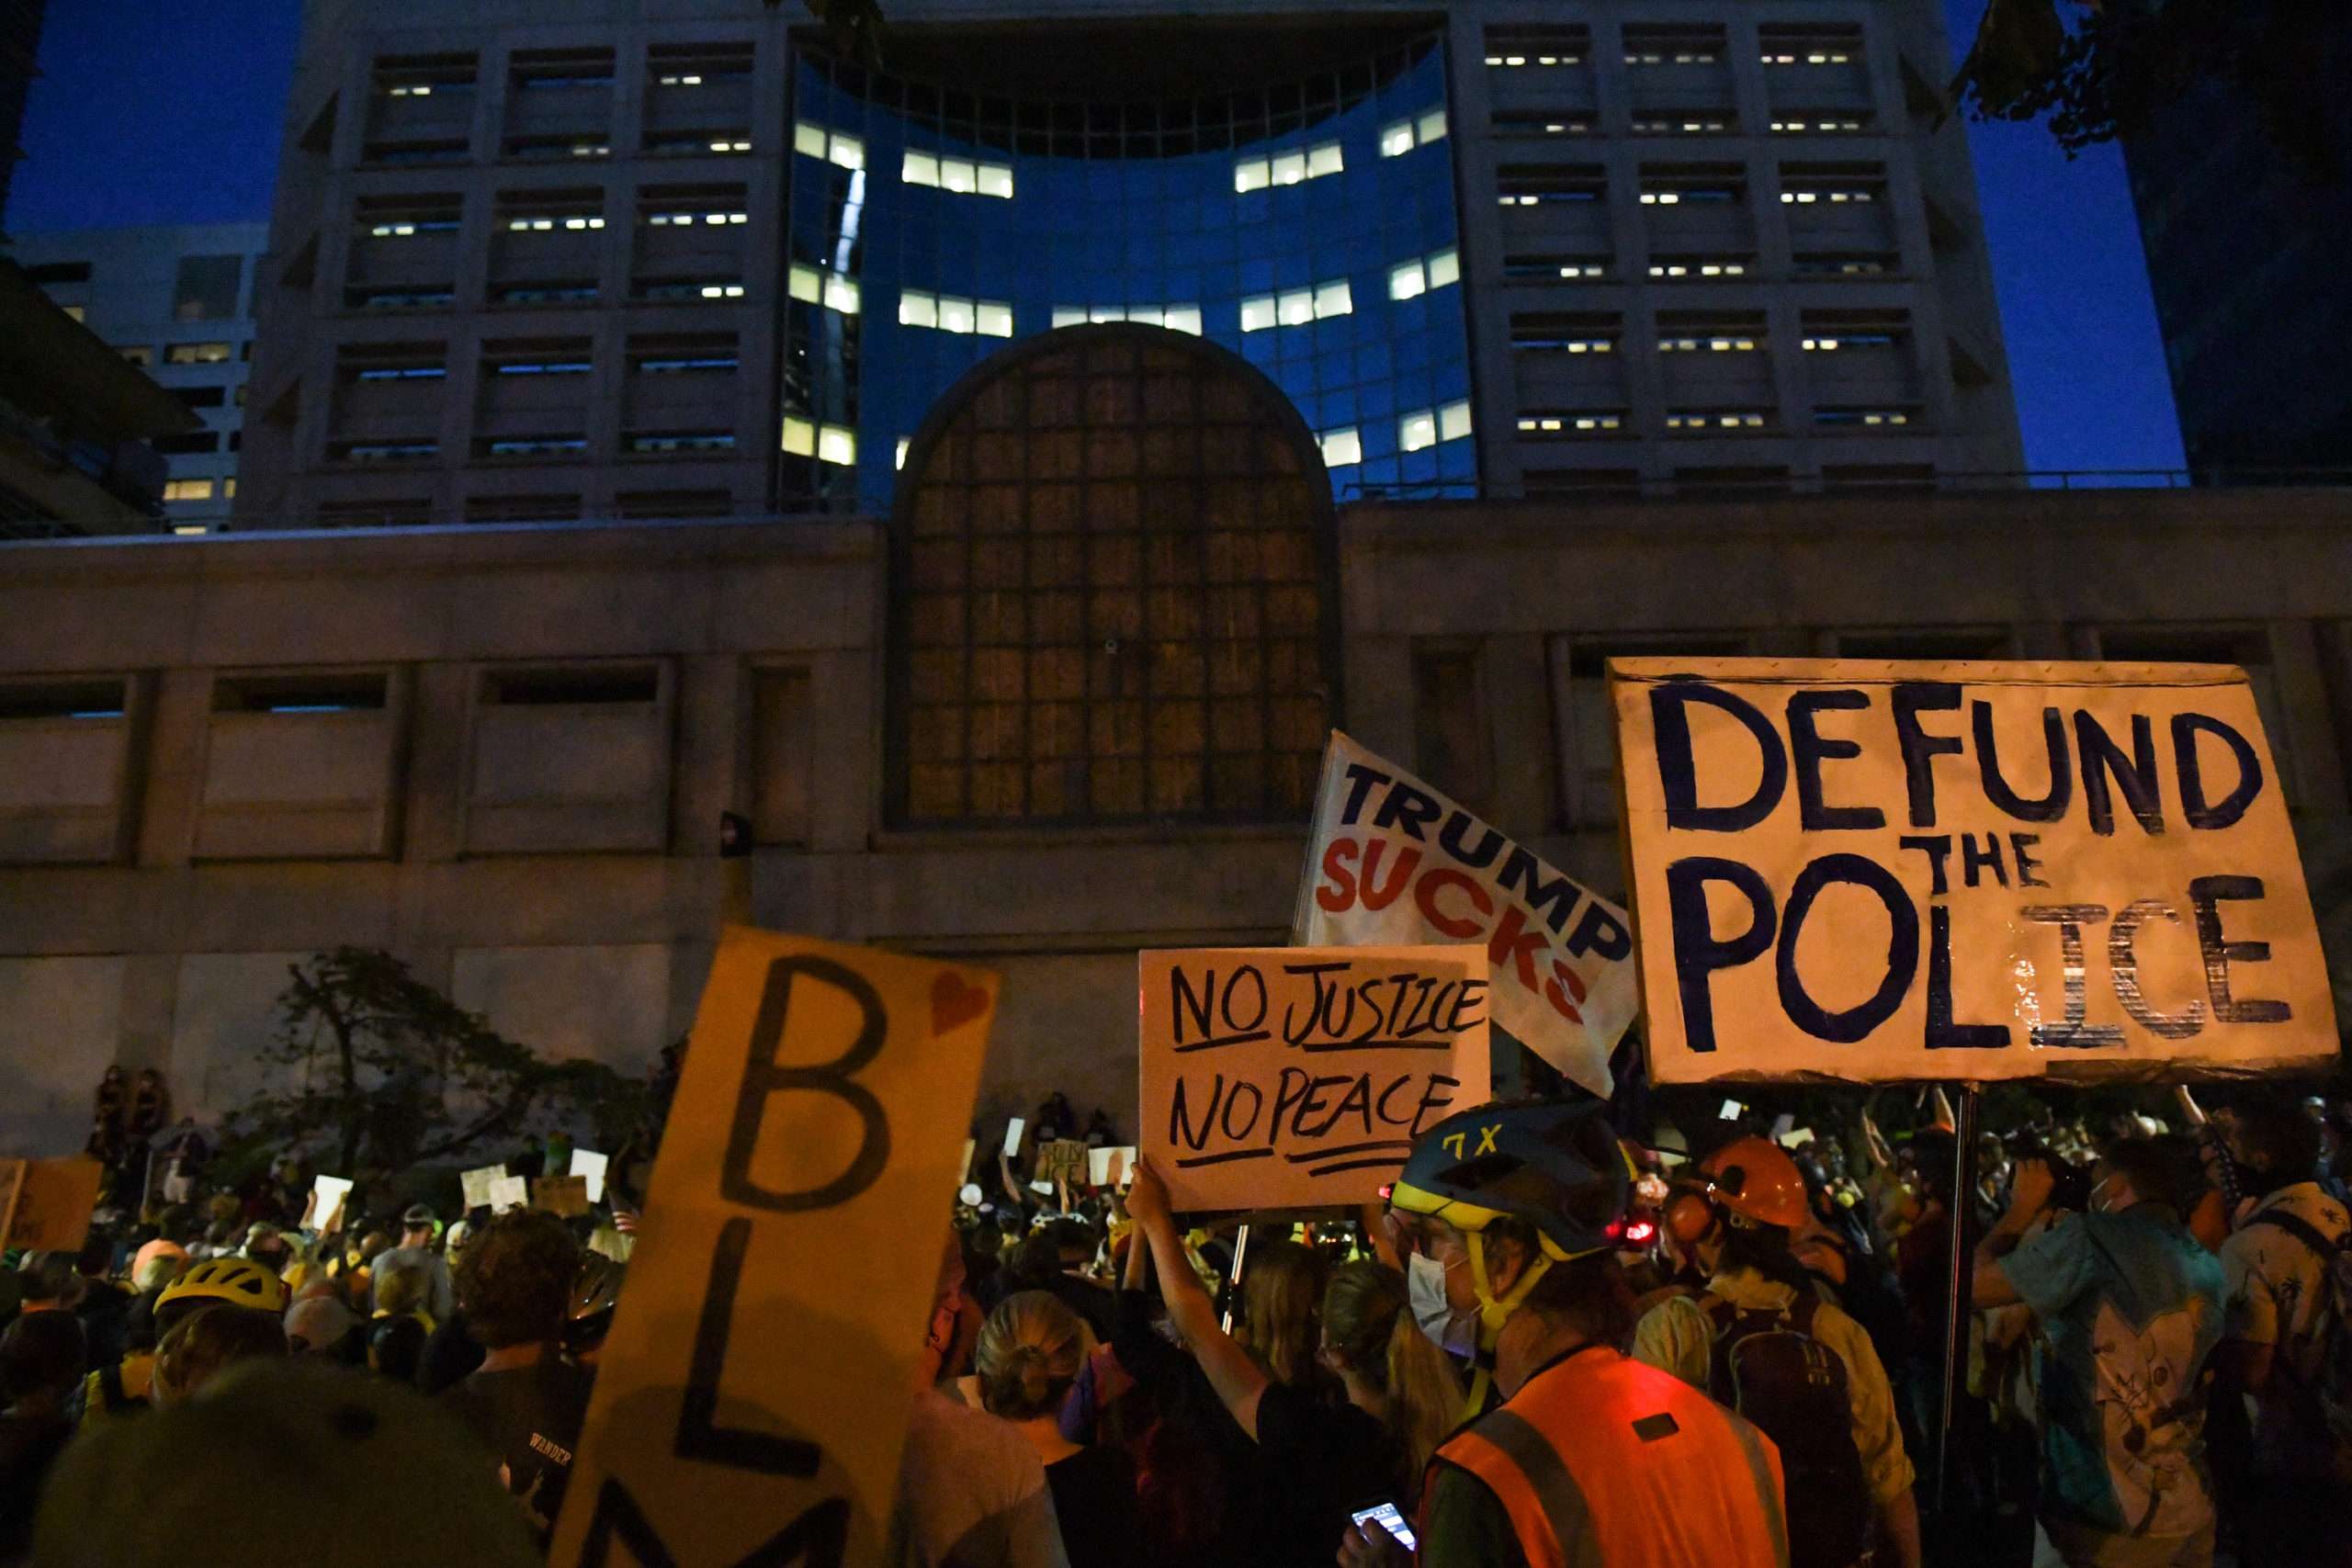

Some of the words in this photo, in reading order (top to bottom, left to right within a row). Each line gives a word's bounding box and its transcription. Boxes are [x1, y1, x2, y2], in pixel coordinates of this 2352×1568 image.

[1650, 674, 2264, 835] DEFUND
[1316, 838, 1587, 1025] SUCKS
[1342, 763, 1633, 962] TRUMP
[1899, 832, 2051, 896] THE
[1170, 964, 1268, 1043] NO
[1283, 962, 1489, 1047] JUSTICE
[1666, 852, 2292, 1053] POLICE
[1170, 1073, 1263, 1150] NO
[1269, 1066, 1461, 1145] PEACE
